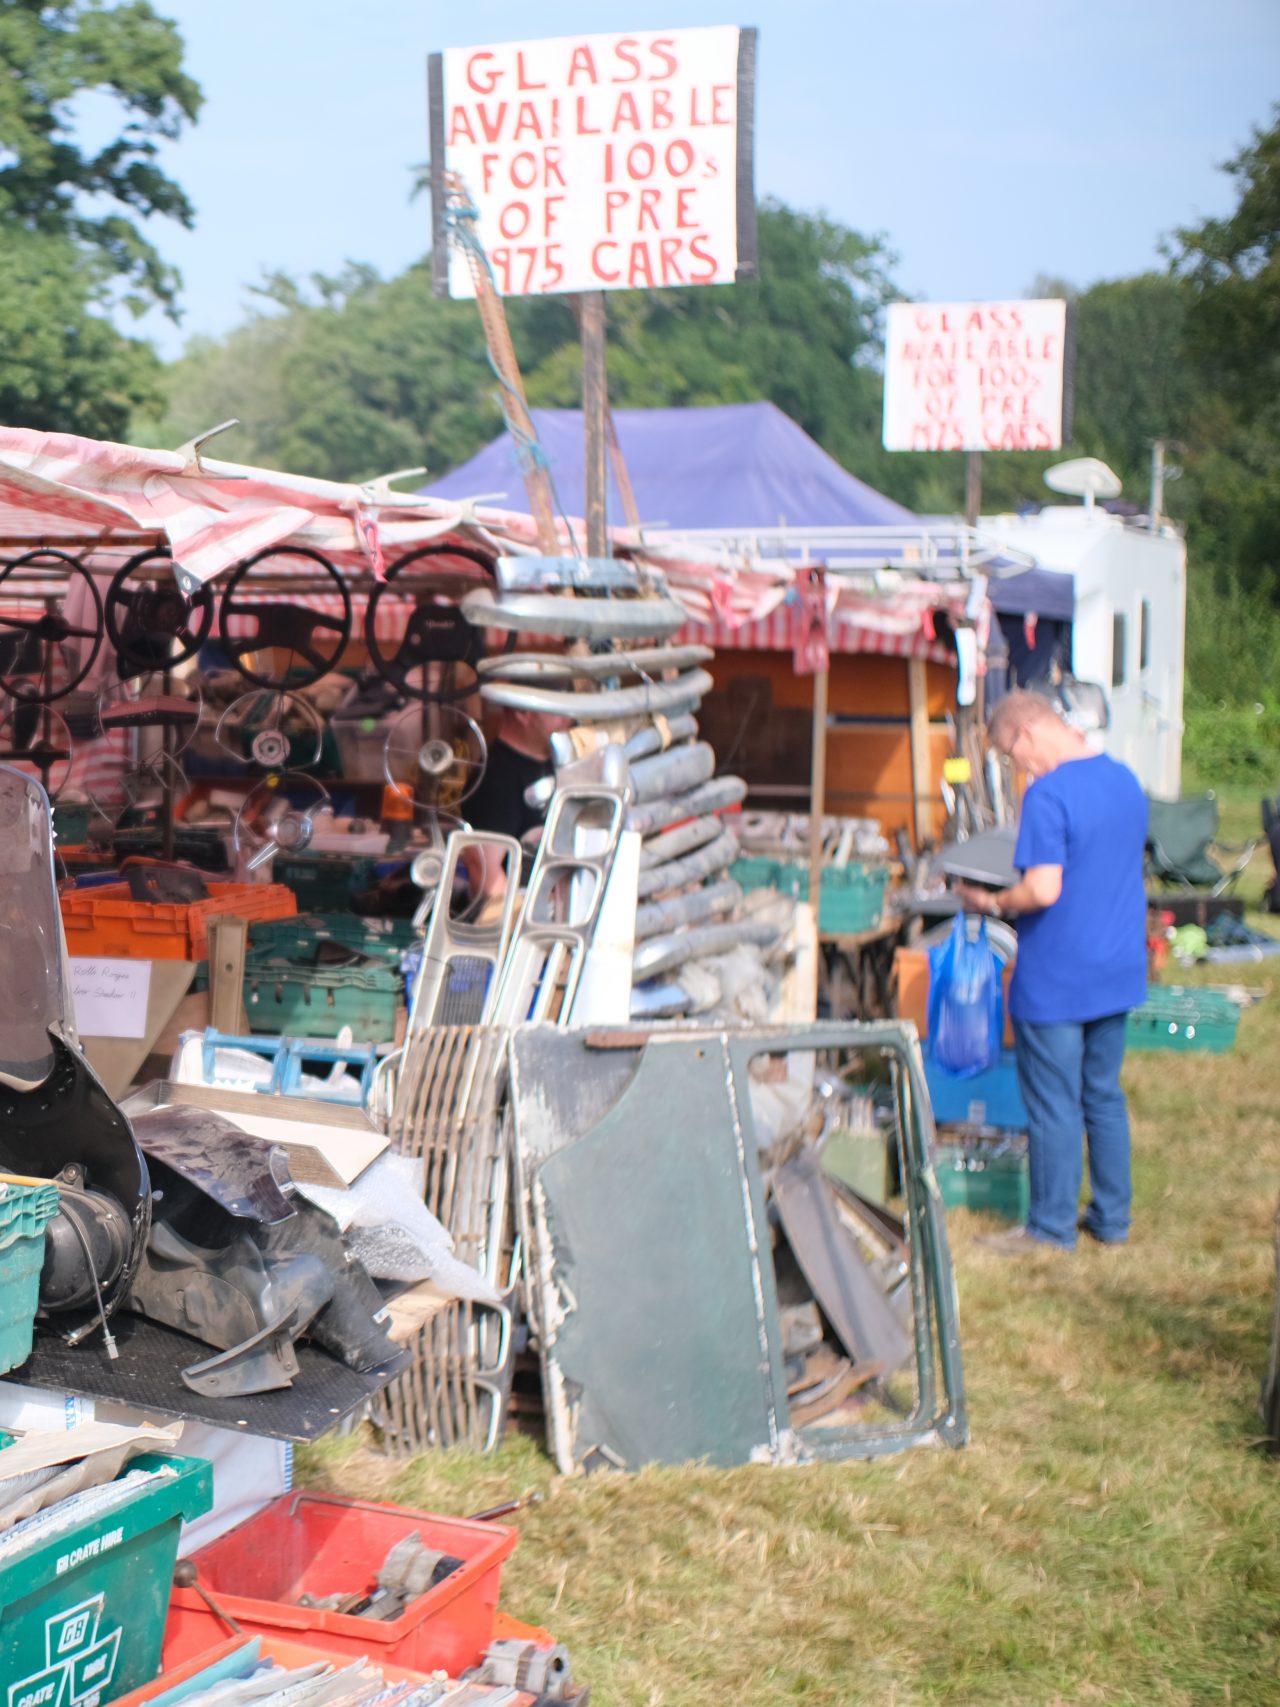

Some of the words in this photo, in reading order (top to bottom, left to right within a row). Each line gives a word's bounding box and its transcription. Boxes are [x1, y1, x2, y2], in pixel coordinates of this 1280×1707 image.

[467, 39, 678, 94] GLASS
[448, 85, 733, 146] AVAILABLE
[482, 146, 566, 193] FOR
[604, 139, 718, 183] 100s
[499, 196, 565, 239] OF
[606, 188, 700, 234] PRE
[490, 244, 563, 294] 975
[591, 234, 718, 288] CARS
[69, 1538, 101, 1567] CRATE
[100, 1526, 124, 1552] HIRE
[17, 1682, 56, 1707] CRATE
